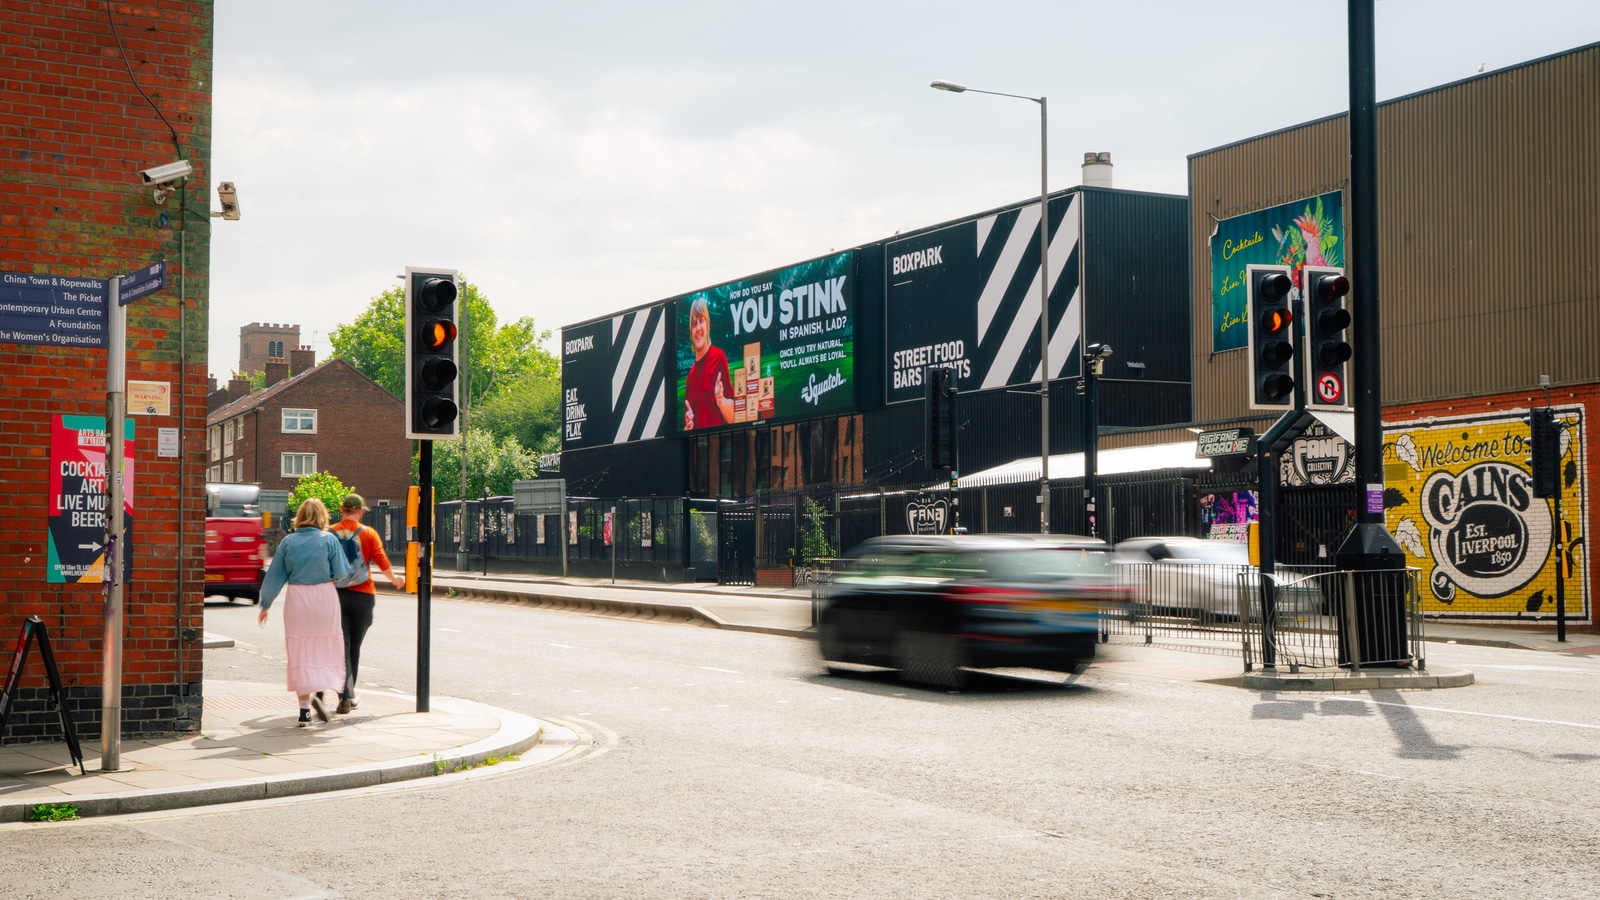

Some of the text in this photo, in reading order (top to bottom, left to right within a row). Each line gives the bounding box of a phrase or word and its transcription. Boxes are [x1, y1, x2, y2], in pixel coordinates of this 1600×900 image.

[1222, 231, 1264, 260] Cocktails
[893, 245, 943, 276] BOXPARK
[4, 274, 102, 289] China Town & Ropewalks
[63, 292, 102, 302] The Picket
[730, 281, 773, 300] HOW DO YOU SAY
[51, 306, 74, 315] Urban
[77, 307, 102, 317] Centre
[730, 275, 847, 336] YOU STINK
[49, 320, 101, 330] A Foundation
[780, 316, 847, 342] IN SPANISH, LAD?
[12, 332, 50, 342] Women's
[52, 334, 101, 344] Organisation
[566, 334, 594, 355] BOXPARK
[780, 338, 844, 358] ONCE YOU TRY NATURAL,
[893, 345, 933, 370] STREET
[934, 340, 964, 363] FOOD
[798, 354, 819, 366] ALWAYS
[820, 354, 827, 363] BE
[828, 350, 847, 361] LOYAL.
[893, 366, 922, 390] BARS
[566, 388, 578, 403] EAT.
[566, 404, 587, 420] DRINK.
[78, 428, 106, 438] ARTS BA
[566, 422, 582, 438] PLAY.
[1199, 431, 1238, 444] BIG FANG
[83, 436, 104, 446] BALTIC
[1294, 436, 1346, 481] FANG
[1420, 440, 1500, 469] Welcome
[80, 478, 103, 494] ART
[56, 494, 84, 510] LIVE
[1428, 466, 1531, 525] CAINS
[909, 508, 944, 533] FANG
[1453, 530, 1519, 566] LIVERPOOL
[1491, 550, 1512, 566] 1850
